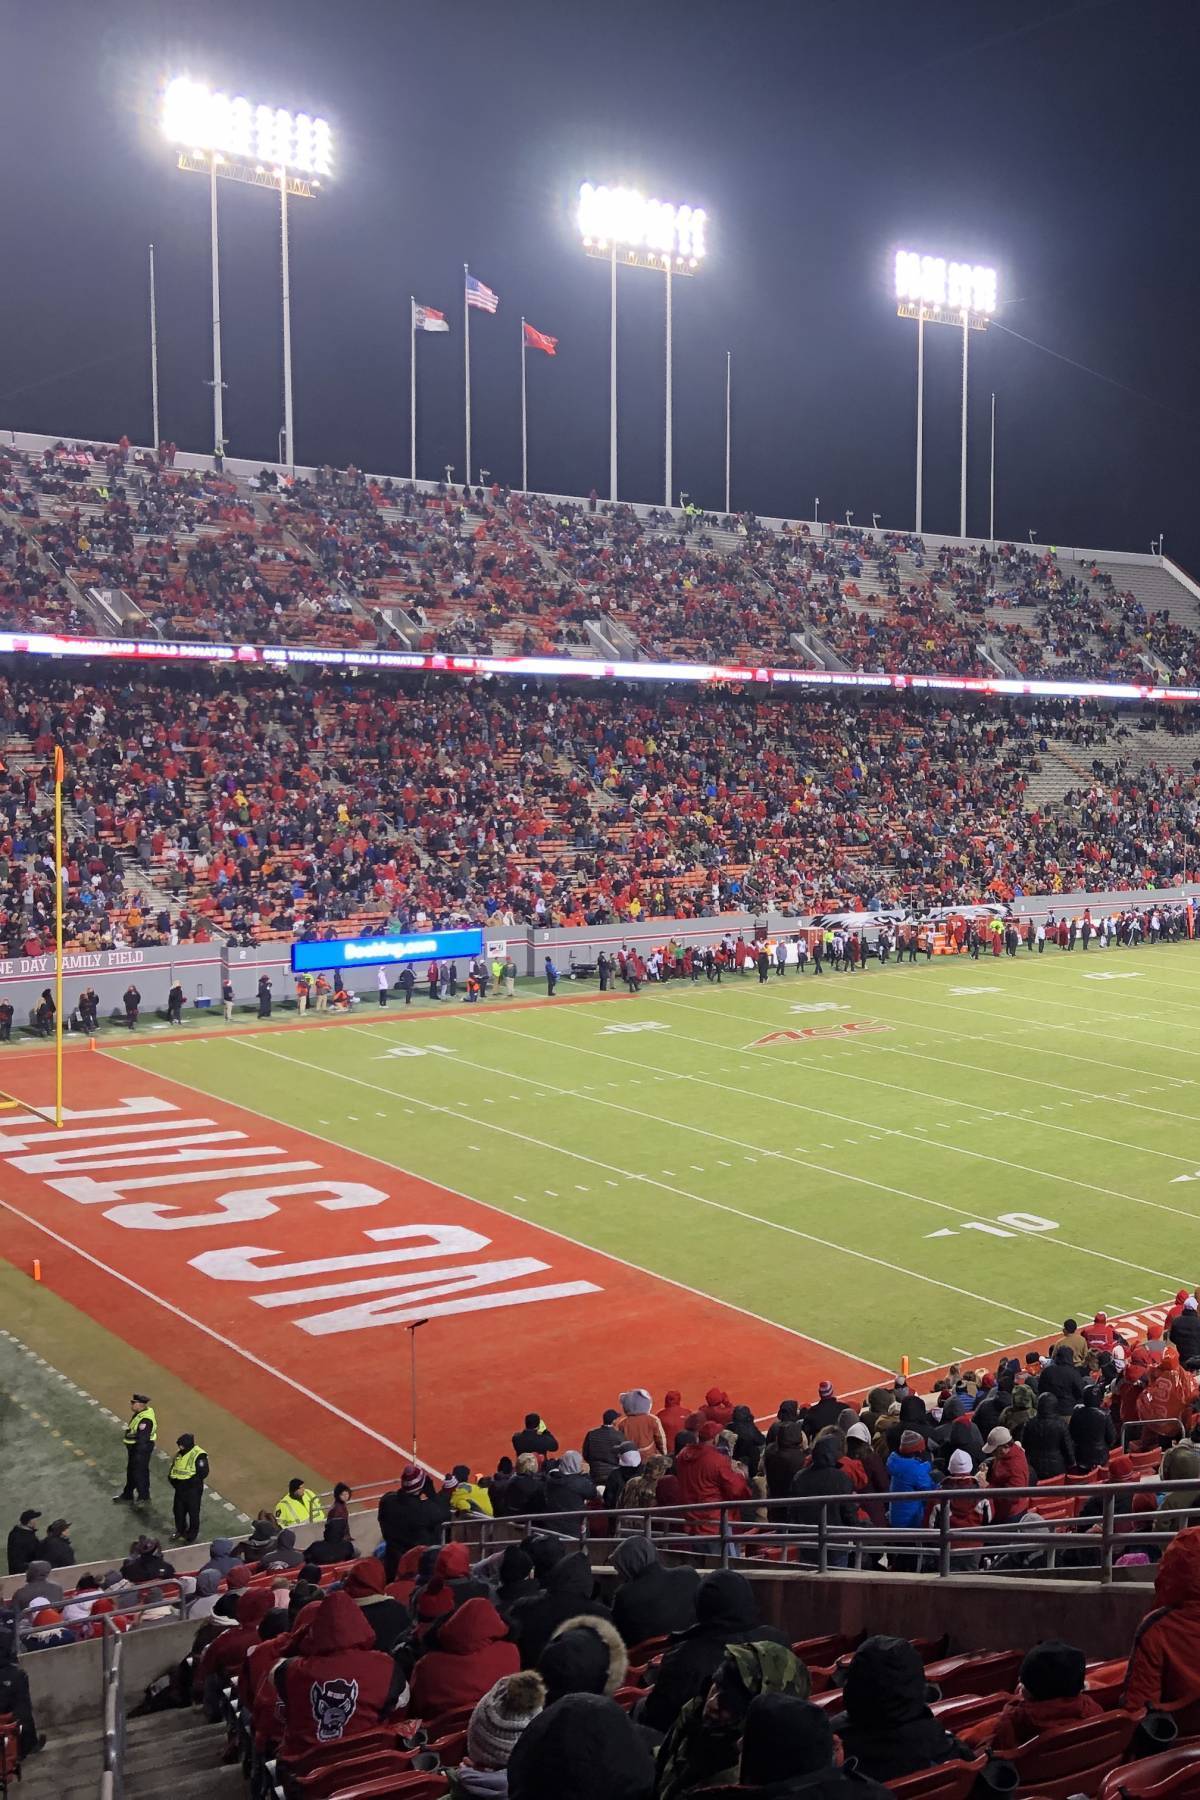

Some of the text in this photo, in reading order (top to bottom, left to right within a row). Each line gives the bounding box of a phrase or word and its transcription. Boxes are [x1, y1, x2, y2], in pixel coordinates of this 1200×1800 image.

[262, 650, 425, 666] ONE THOUSAND MEALS DONATED
[21, 959, 48, 973] DAY
[108, 951, 144, 966] FIELD
[239, 950, 247, 960] 2
[752, 1020, 892, 1046] ACC
[960, 1212, 1060, 1238] 10
[187, 1223, 605, 1336] NC
